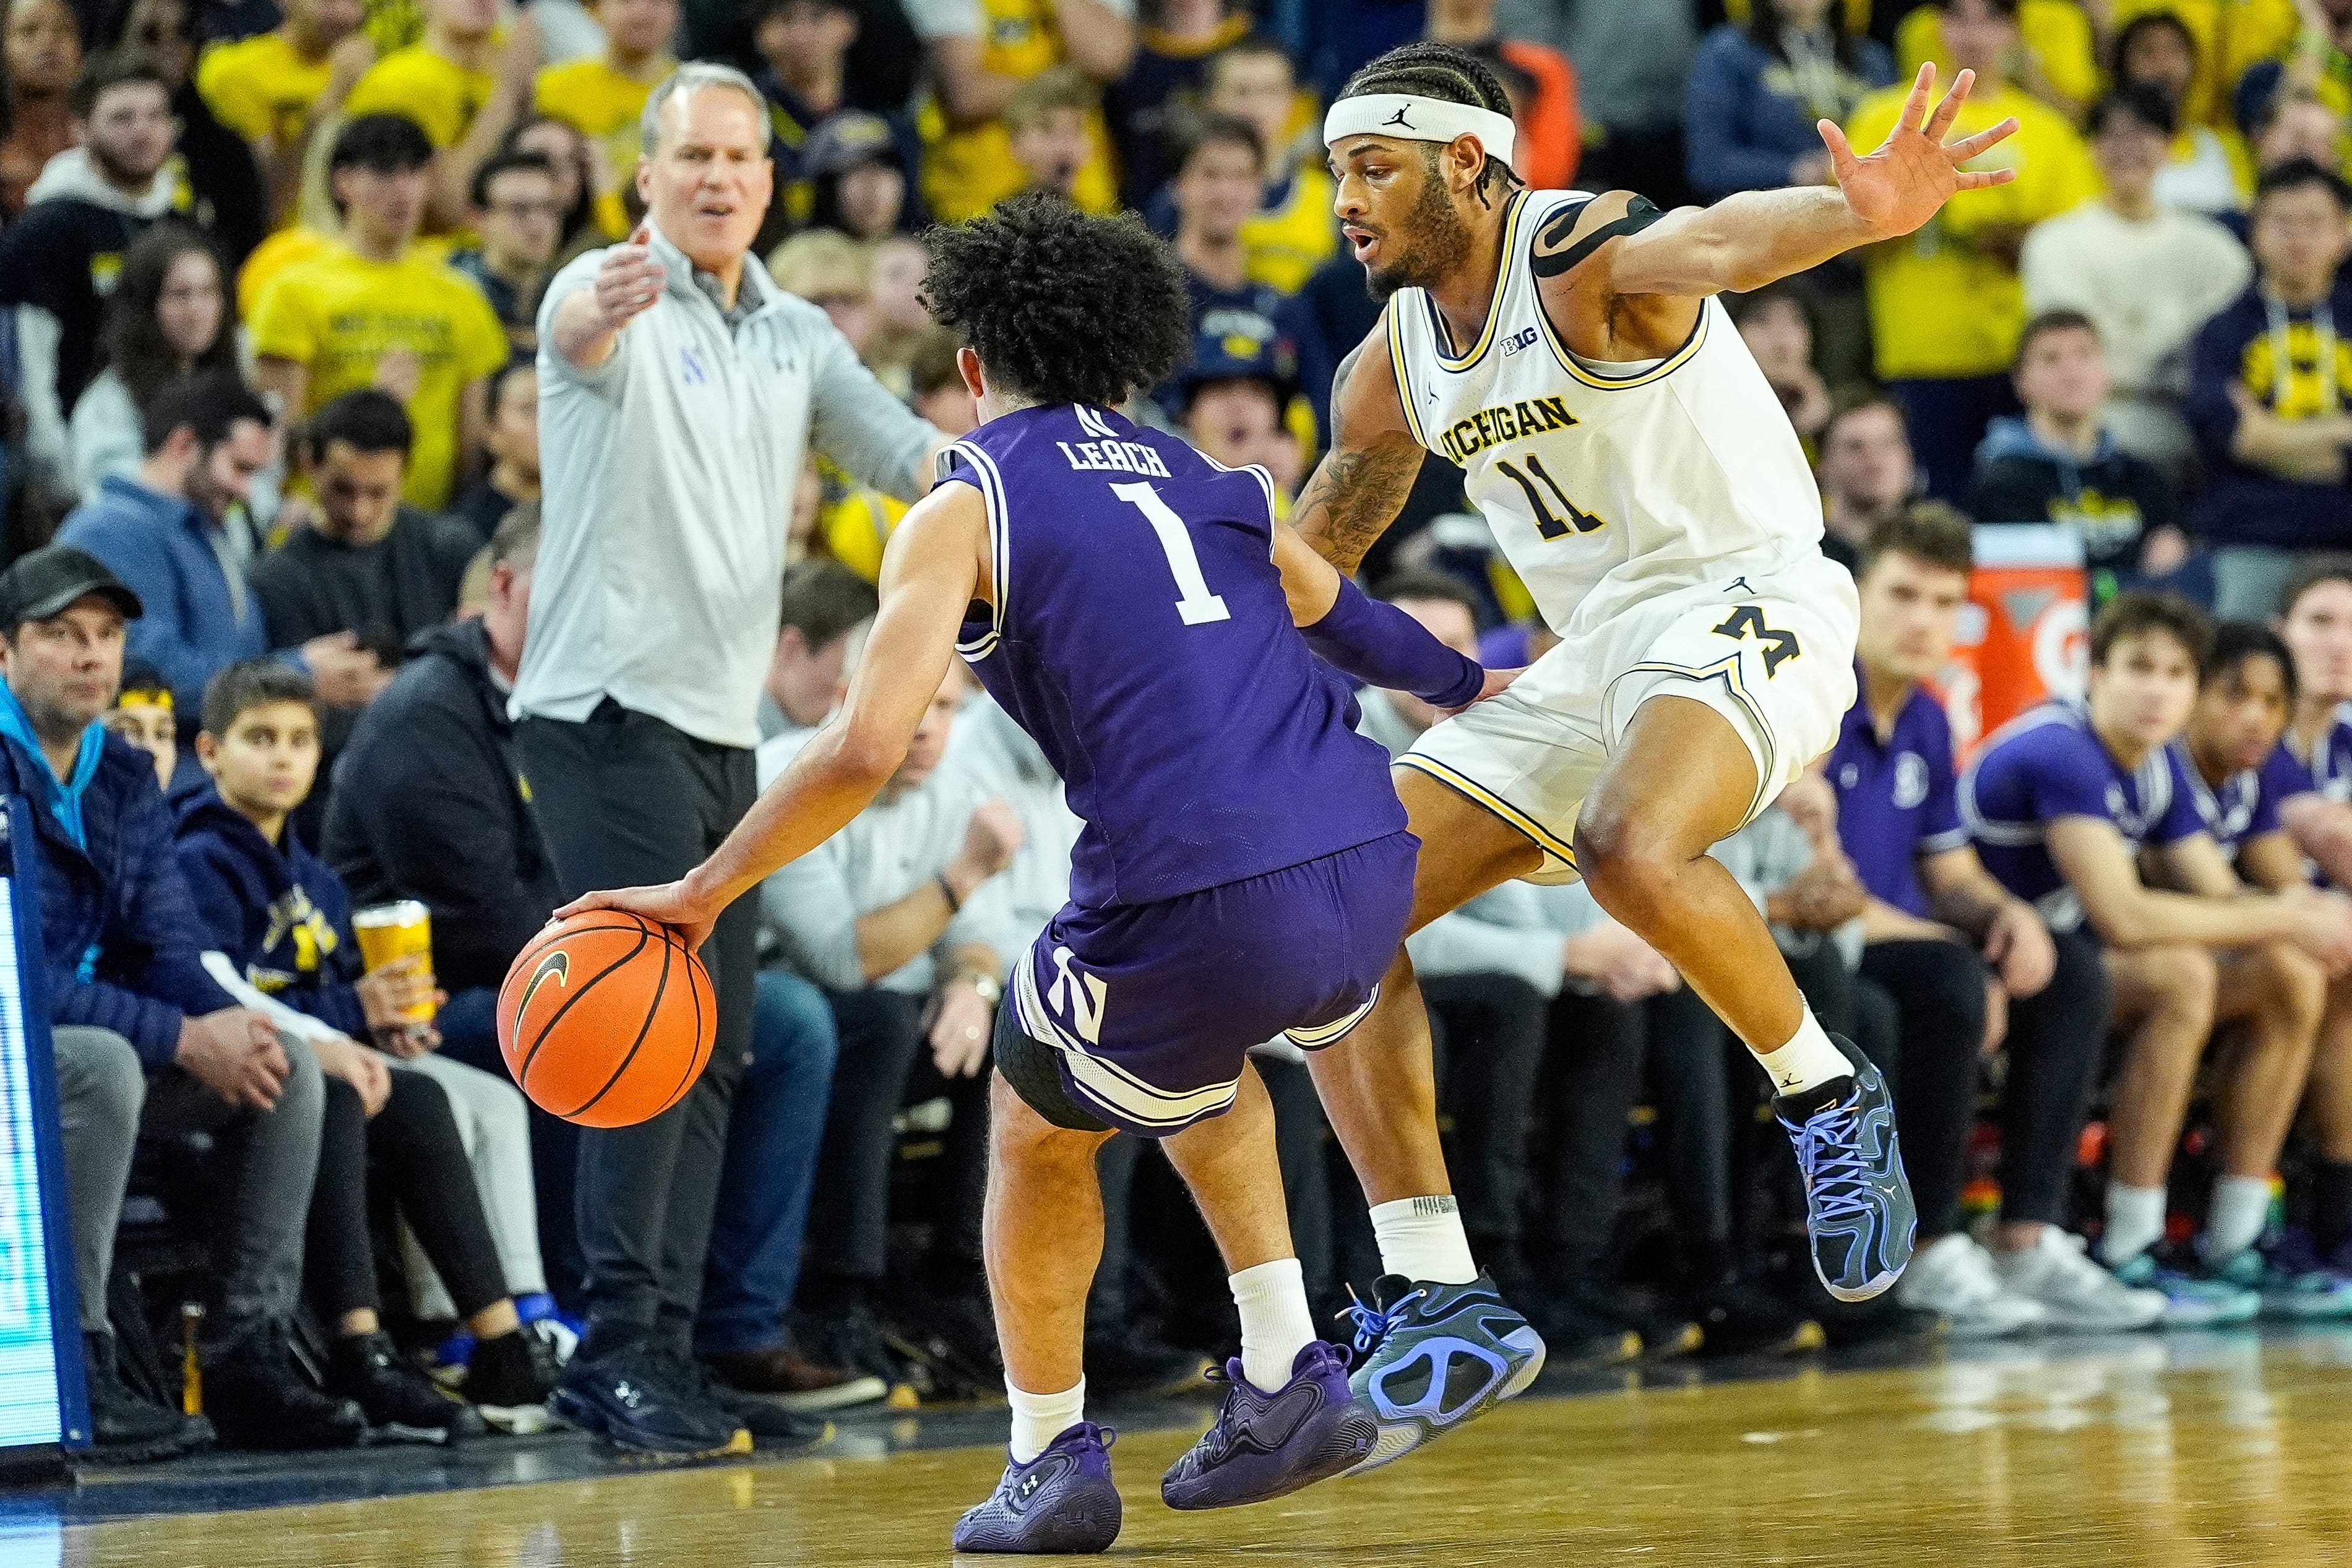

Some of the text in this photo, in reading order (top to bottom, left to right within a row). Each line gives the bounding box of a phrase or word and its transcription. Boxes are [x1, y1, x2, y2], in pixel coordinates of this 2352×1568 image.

[1073, 402, 1120, 437] N
[1439, 395, 1580, 465] ICHIGAN
[1056, 439, 1172, 478] LEACH
[1496, 453, 1606, 541] 11
[1108, 481, 1231, 626] 1
[1711, 605, 1801, 681] M
